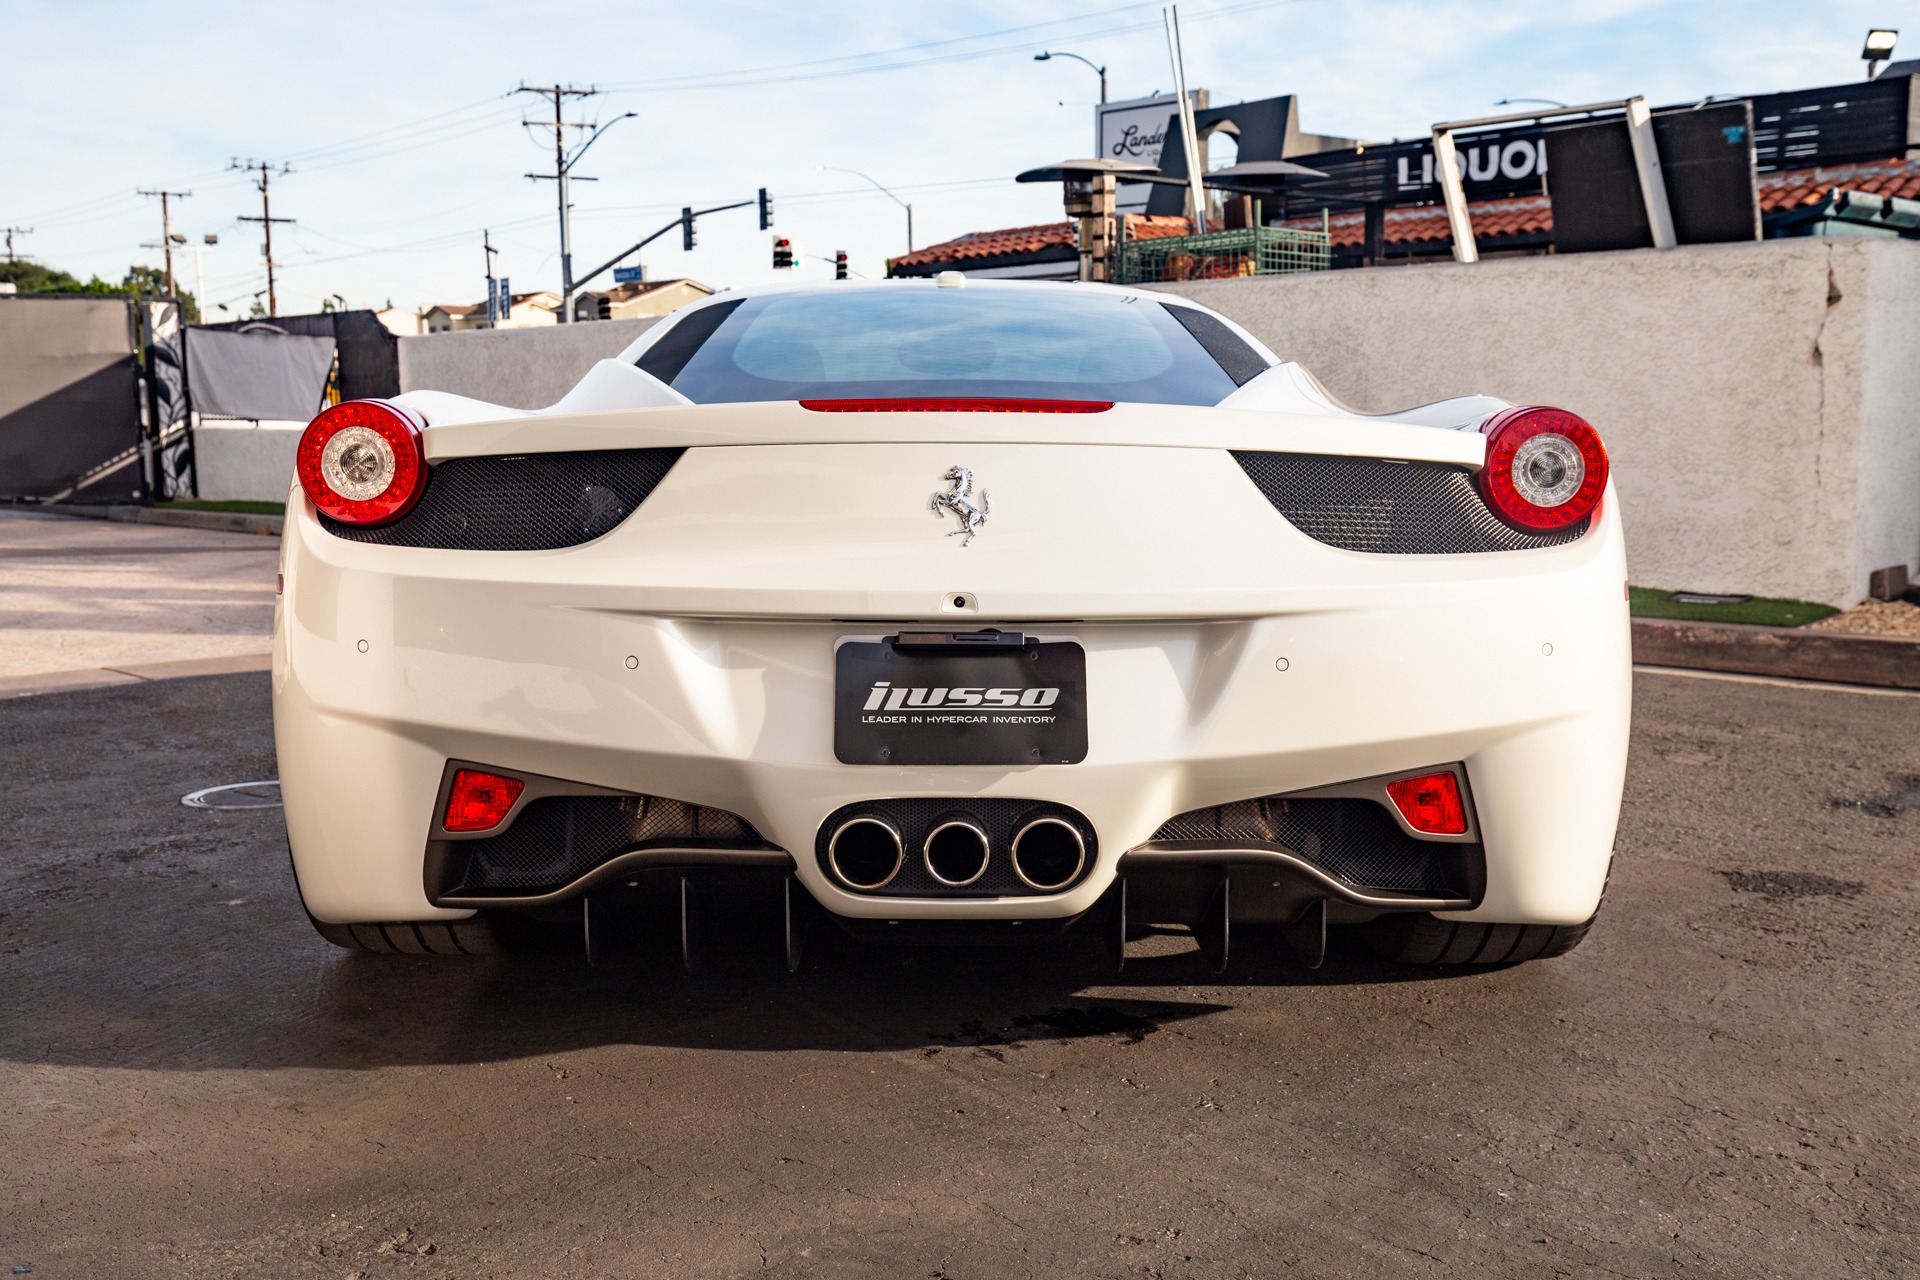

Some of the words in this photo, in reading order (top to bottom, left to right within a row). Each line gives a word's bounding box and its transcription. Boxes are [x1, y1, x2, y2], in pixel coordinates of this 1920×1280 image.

[862, 715, 907, 724] LEADER
[911, 715, 923, 724] IN
[926, 715, 988, 724] HYPERCAR
[992, 715, 1057, 724] INVENTORY
